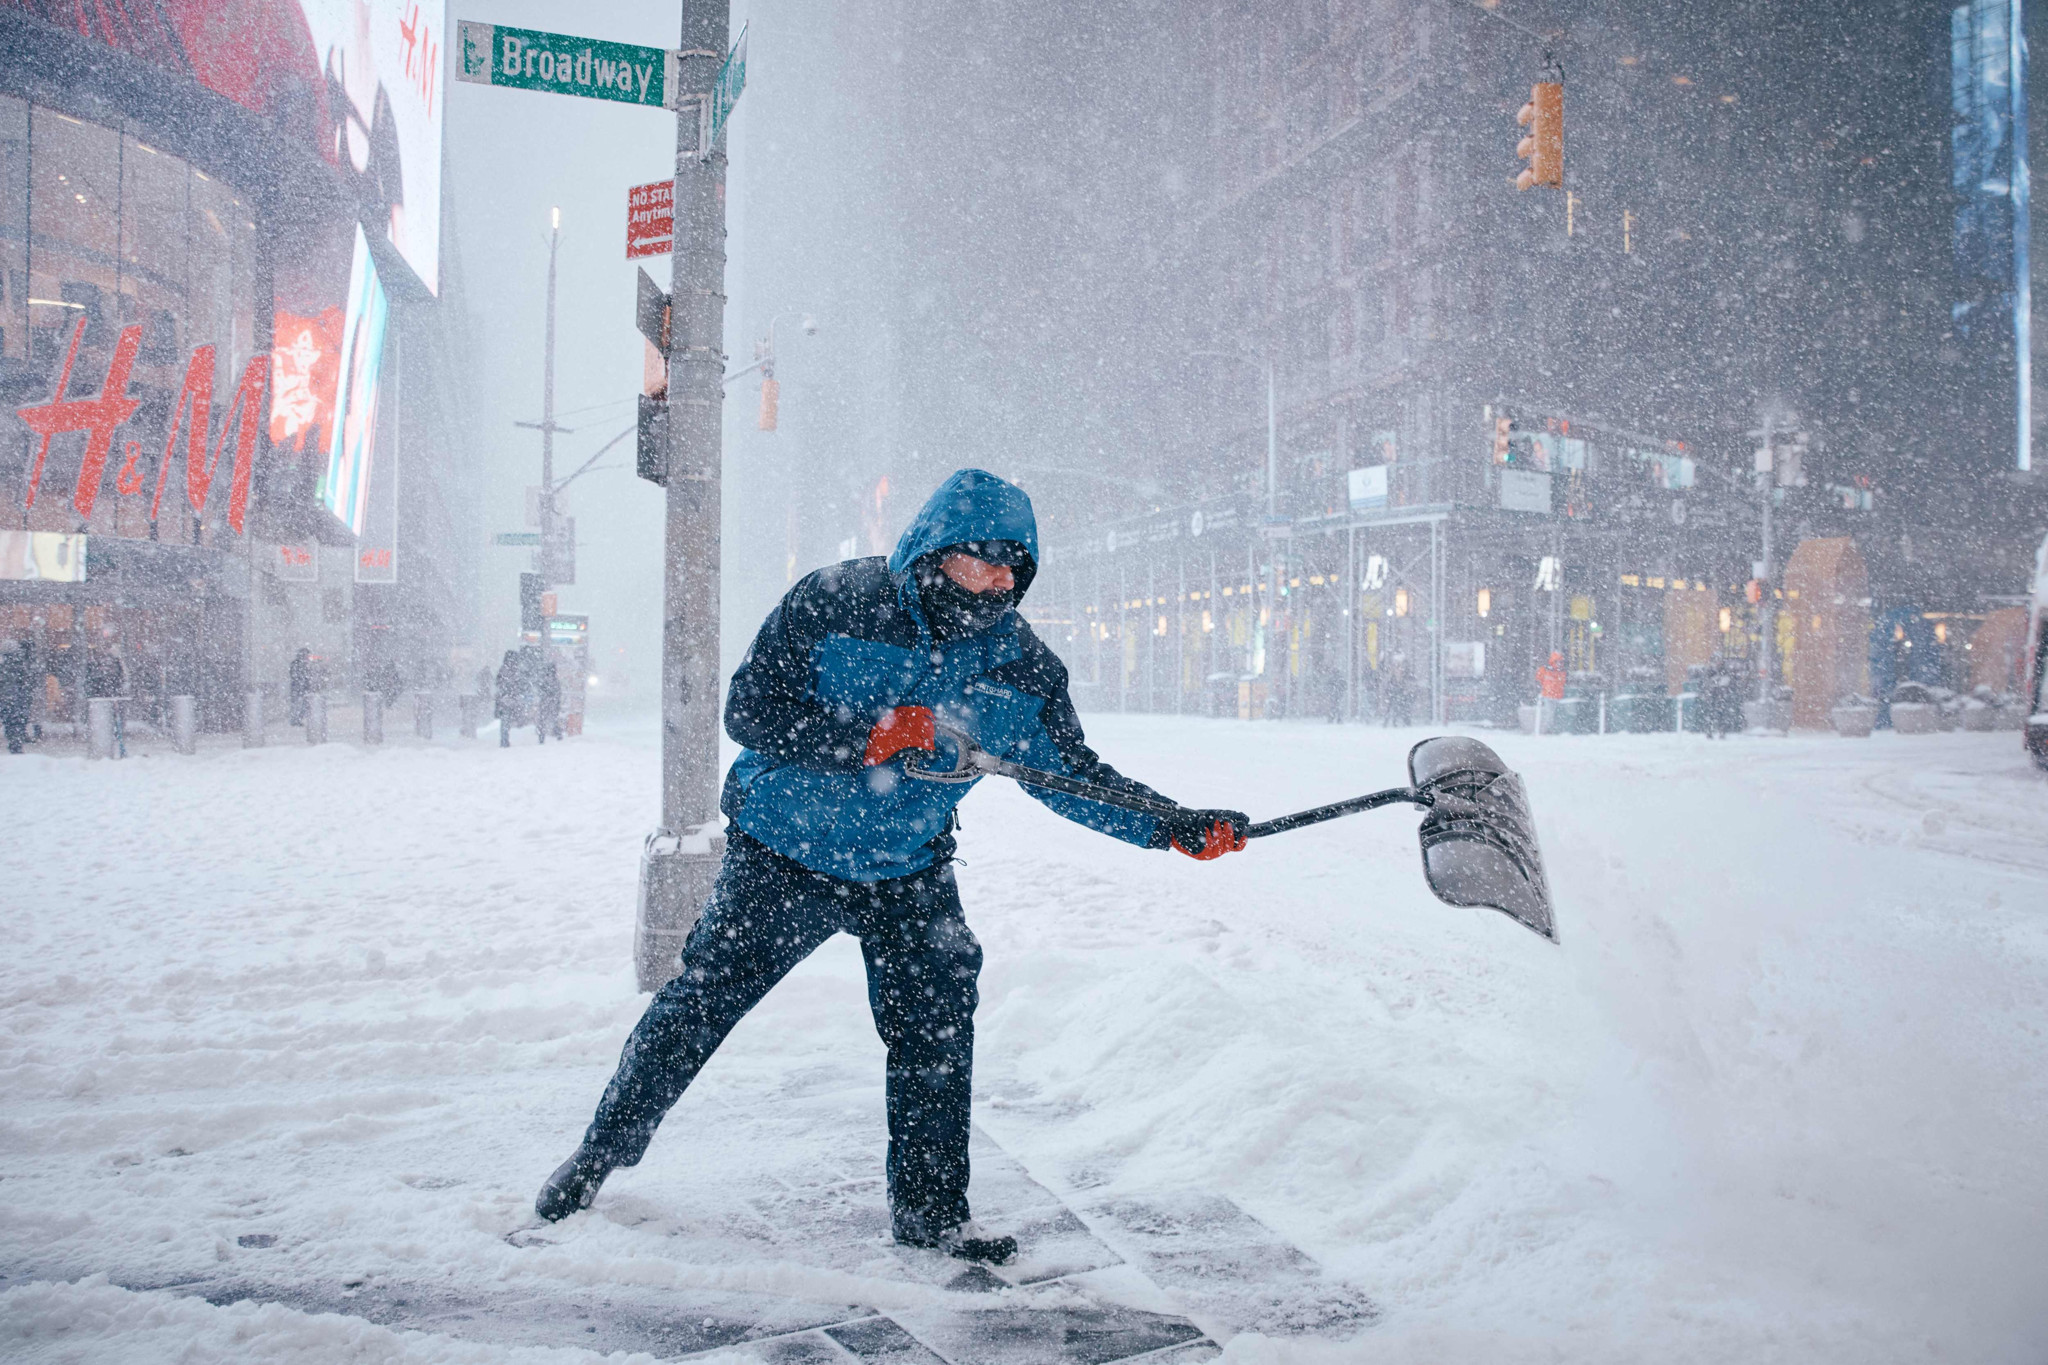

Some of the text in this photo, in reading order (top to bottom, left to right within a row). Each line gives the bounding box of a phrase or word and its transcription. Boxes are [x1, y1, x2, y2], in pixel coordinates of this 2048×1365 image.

[503, 35, 654, 103] Broadway
[632, 190, 648, 207] NO
[16, 316, 270, 535] H&M
